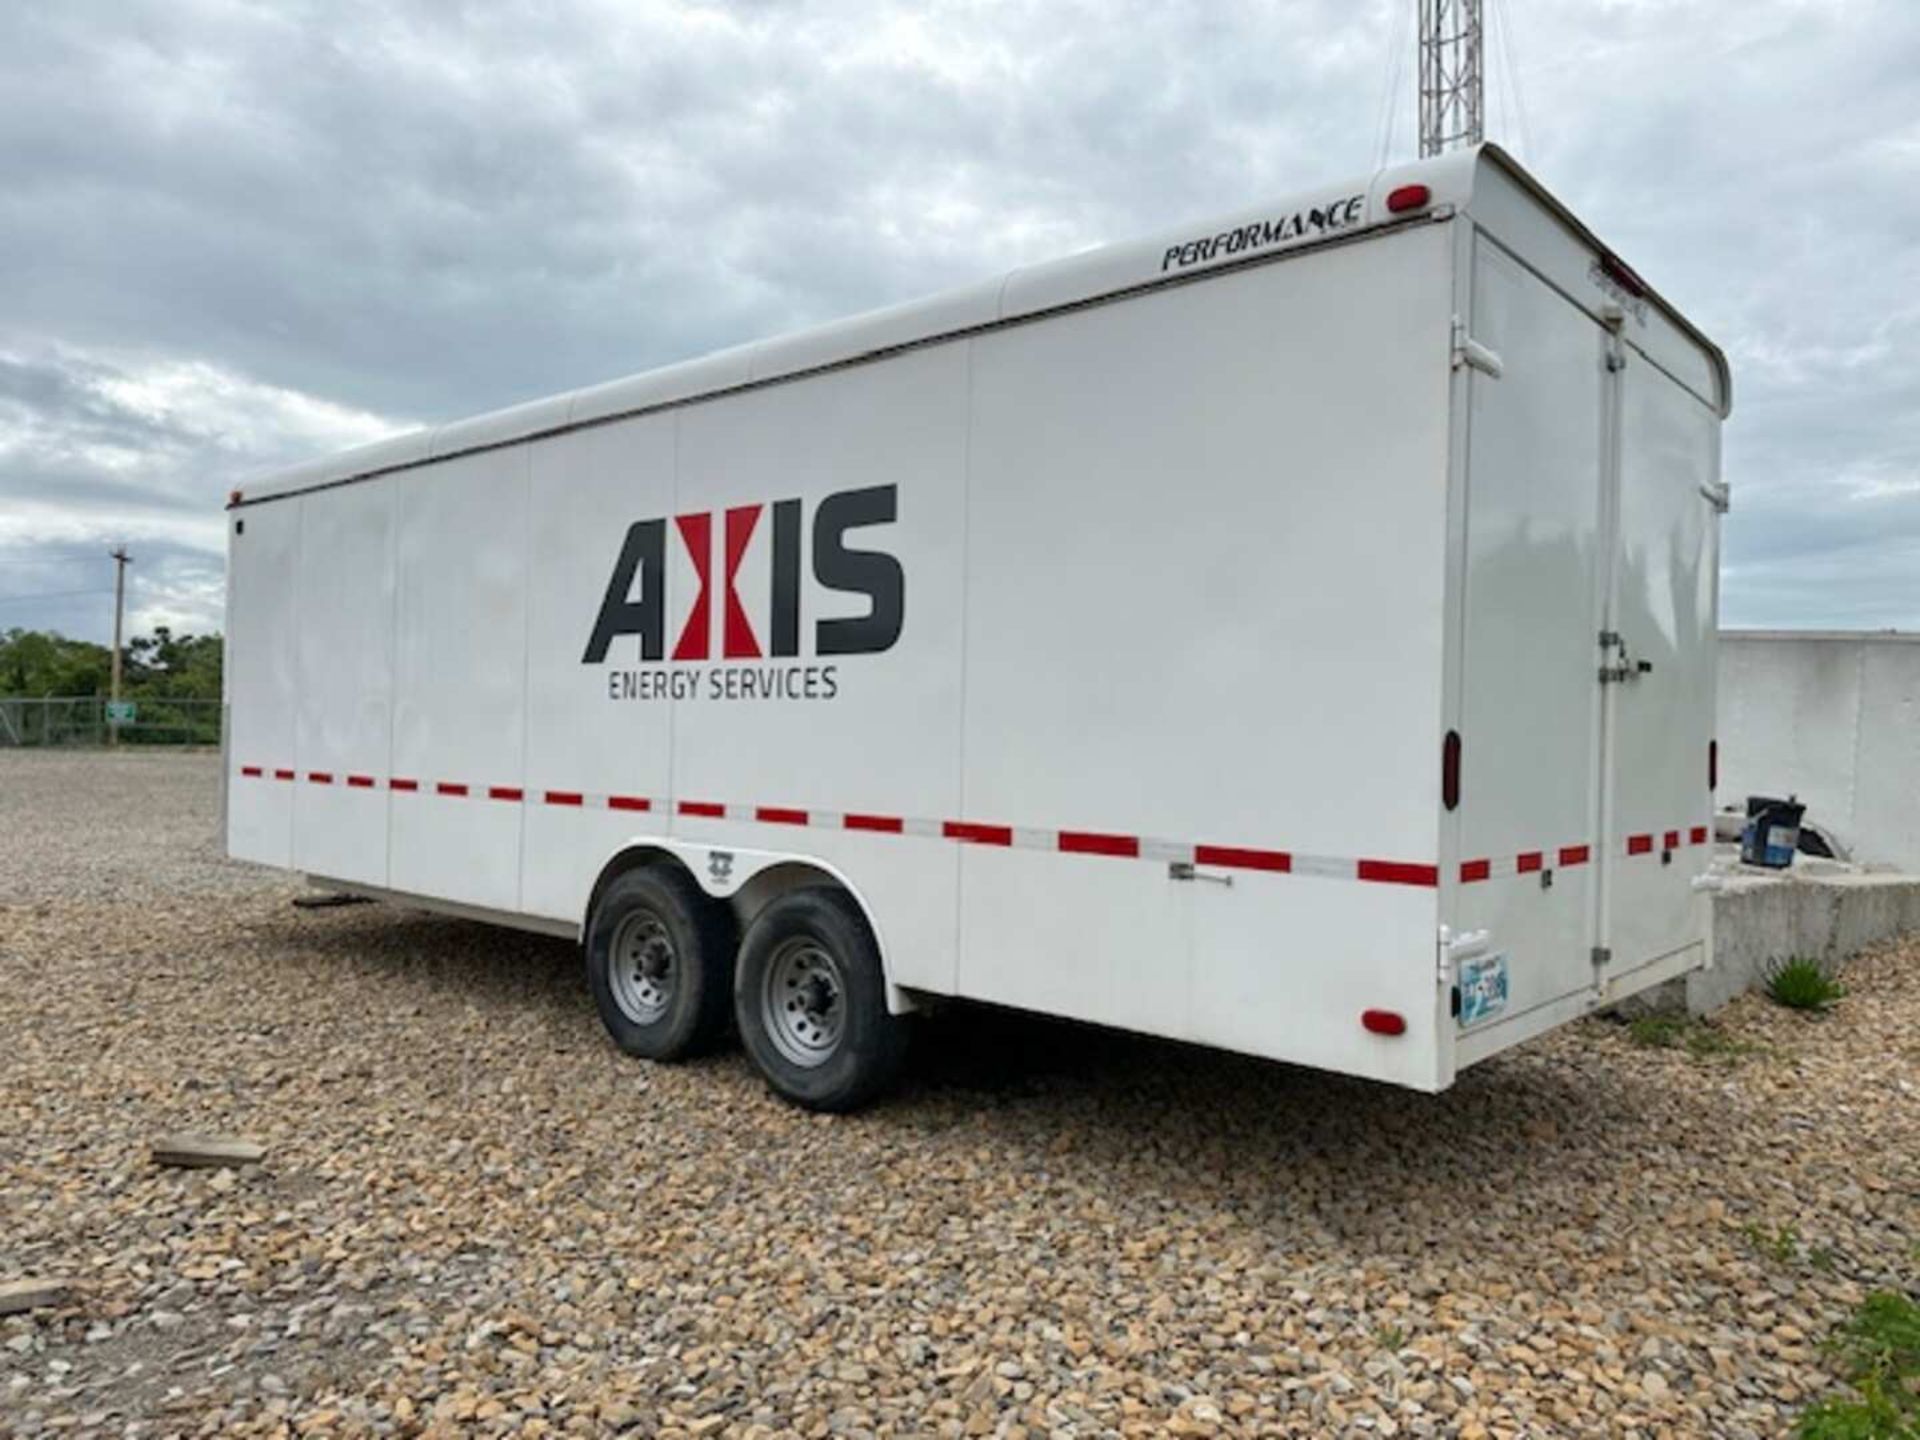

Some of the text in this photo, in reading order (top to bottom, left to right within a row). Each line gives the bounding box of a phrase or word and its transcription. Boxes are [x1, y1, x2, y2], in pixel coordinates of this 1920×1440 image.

[1162, 195, 1365, 270] PERFORMANCE
[581, 483, 905, 665] AXIS
[608, 665, 838, 700] ENERGY SERVICES
